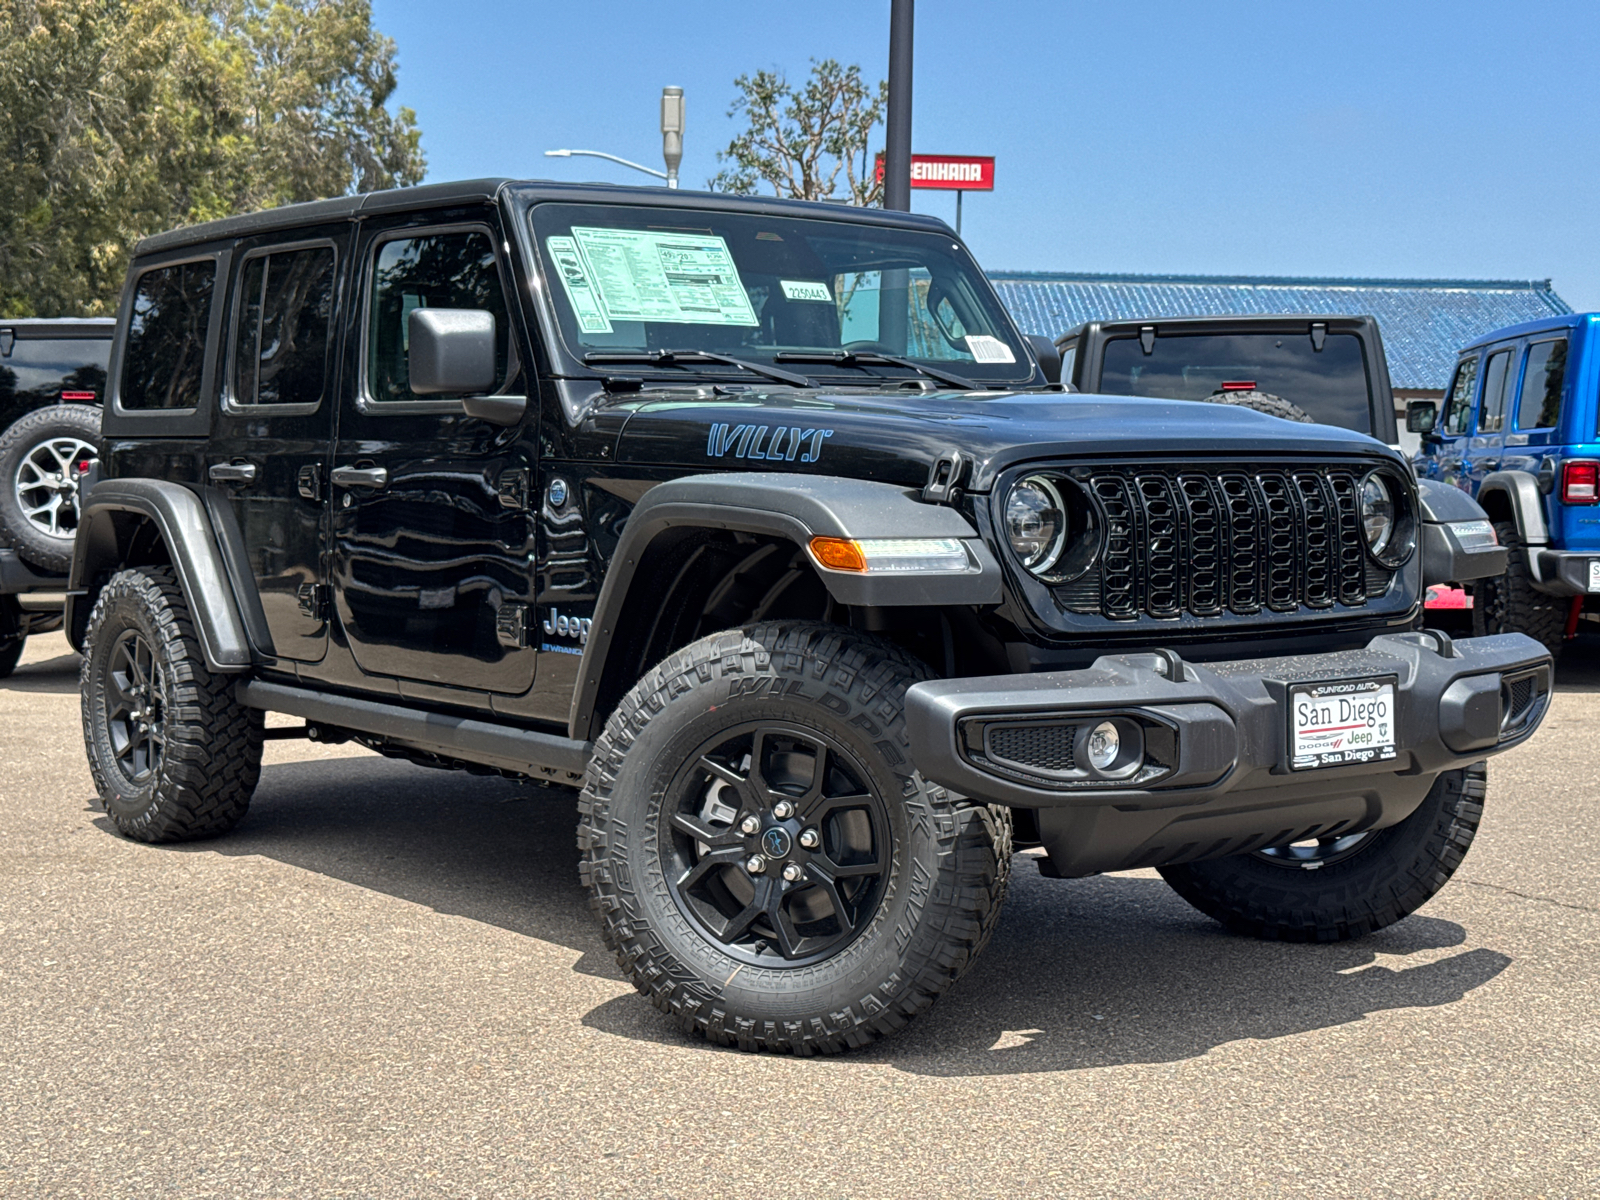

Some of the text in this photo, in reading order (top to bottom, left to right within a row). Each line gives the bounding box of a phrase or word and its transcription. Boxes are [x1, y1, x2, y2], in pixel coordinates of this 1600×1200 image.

[911, 162, 982, 181] ENIHANA
[789, 287, 828, 300] 2250443
[707, 423, 834, 462] WILLYS
[543, 607, 592, 645] Jeep
[1317, 682, 1376, 694] SUNROAD AUTO
[1298, 696, 1387, 728] San Diego
[1298, 741, 1337, 750] DODGE
[1347, 730, 1373, 745] Jeep
[727, 675, 930, 838] WILDPEAK
[1321, 749, 1374, 763] San Diego
